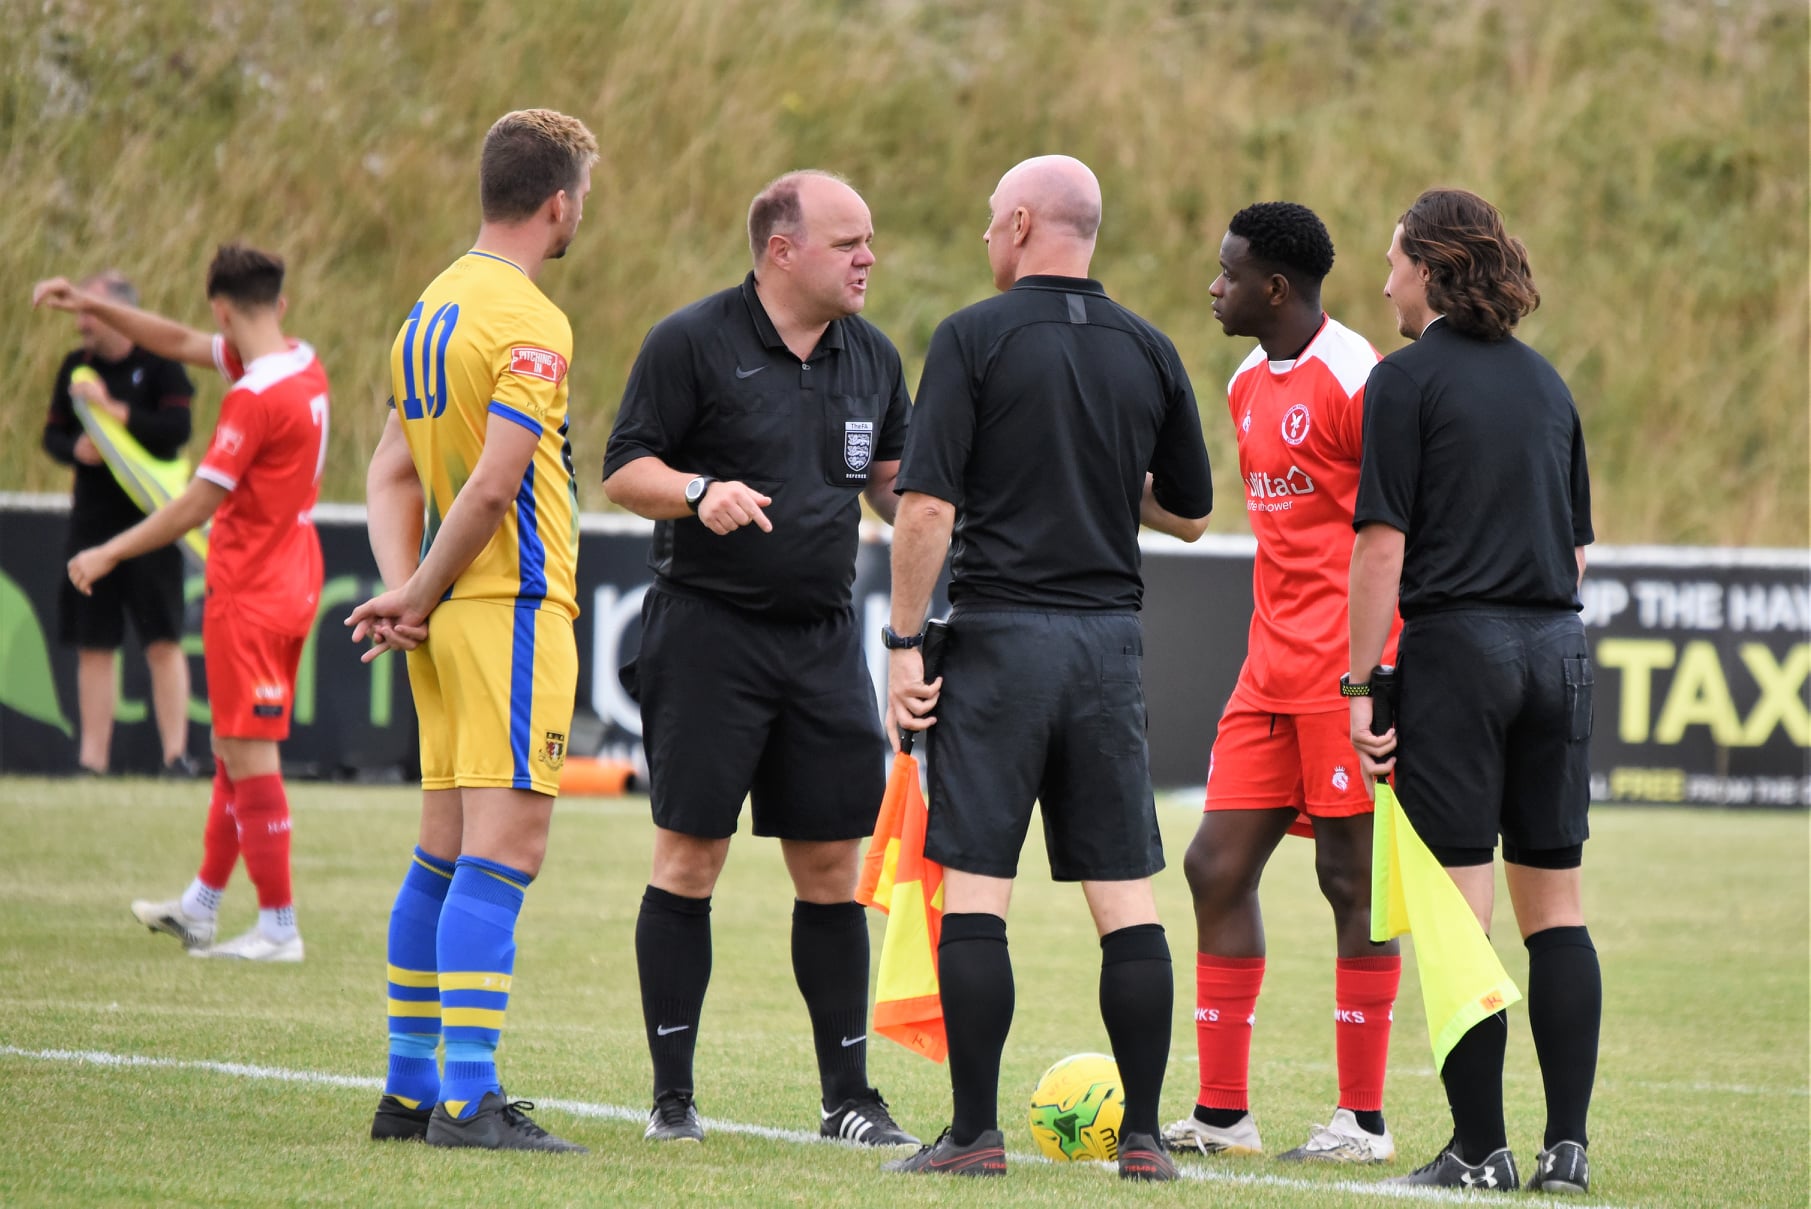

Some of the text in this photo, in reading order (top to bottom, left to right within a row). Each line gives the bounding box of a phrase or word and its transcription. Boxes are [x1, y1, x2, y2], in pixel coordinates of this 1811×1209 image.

[403, 301, 459, 420] 10
[519, 350, 552, 366] PITCHING
[534, 361, 542, 373] IN
[309, 392, 328, 486] 7
[1632, 580, 1723, 629] THE
